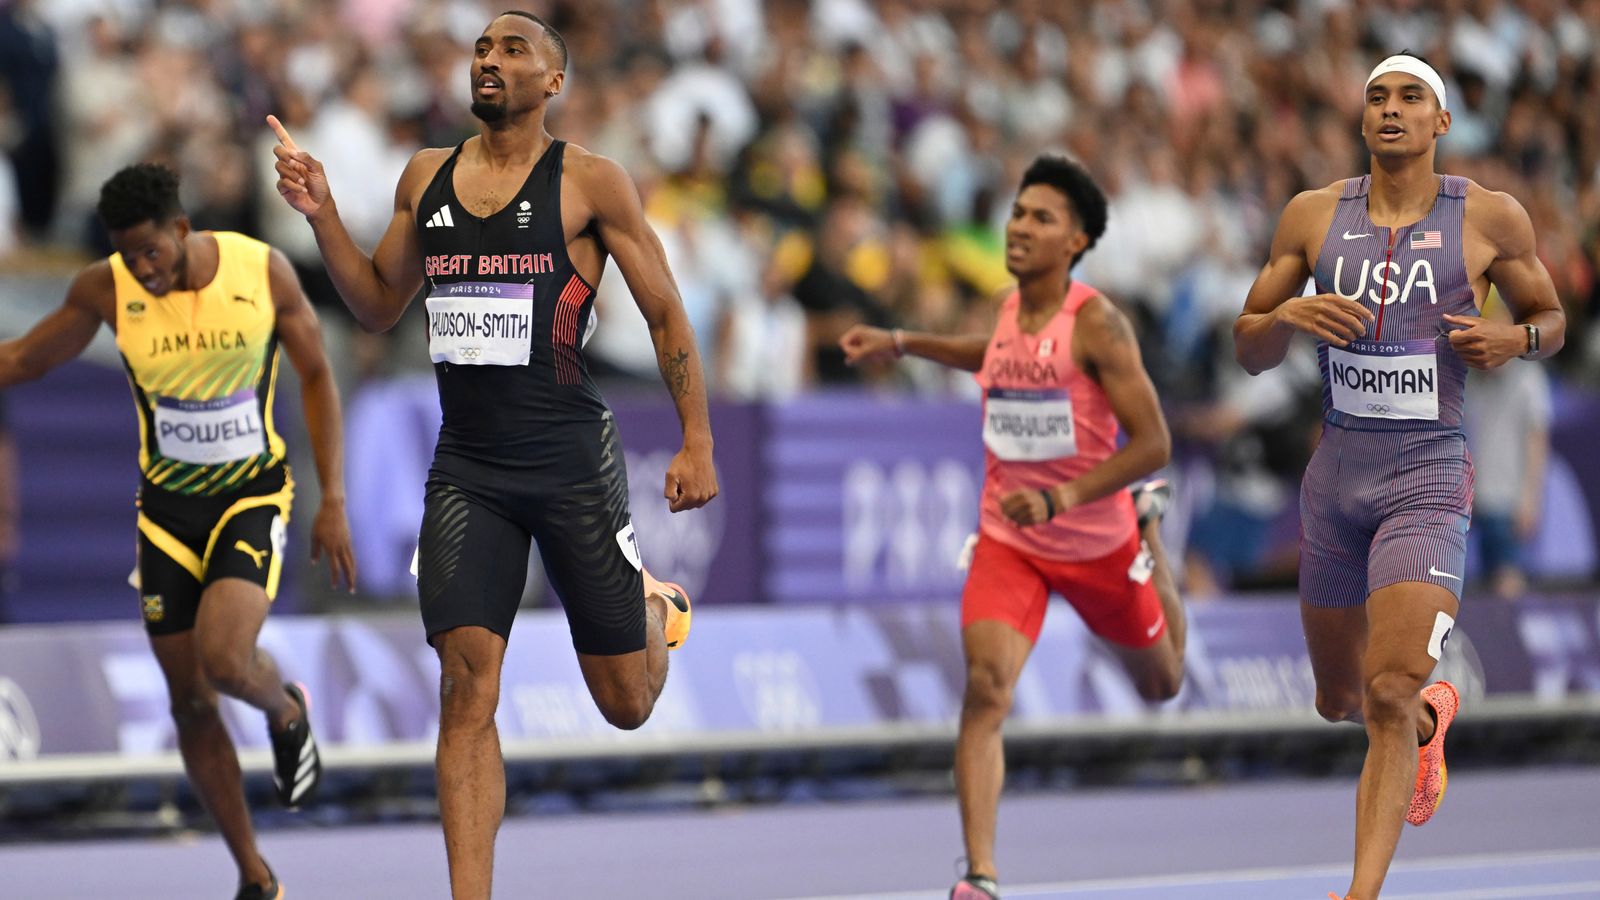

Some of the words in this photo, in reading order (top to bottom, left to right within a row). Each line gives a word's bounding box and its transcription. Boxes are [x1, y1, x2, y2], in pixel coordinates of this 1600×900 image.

[425, 254, 472, 277] GREAT
[478, 252, 554, 275] BRITAIN
[449, 285, 473, 293] PARIS
[475, 285, 501, 294] 2024
[1333, 256, 1438, 305] USA
[431, 311, 529, 339] HUDSON-SMITH
[148, 330, 247, 358] JAMAICA
[1351, 342, 1377, 352] PARIS
[1379, 345, 1406, 353] 2024
[989, 358, 1059, 385] CANADA
[1332, 361, 1434, 394] NORMAN
[160, 414, 259, 443] POWELL
